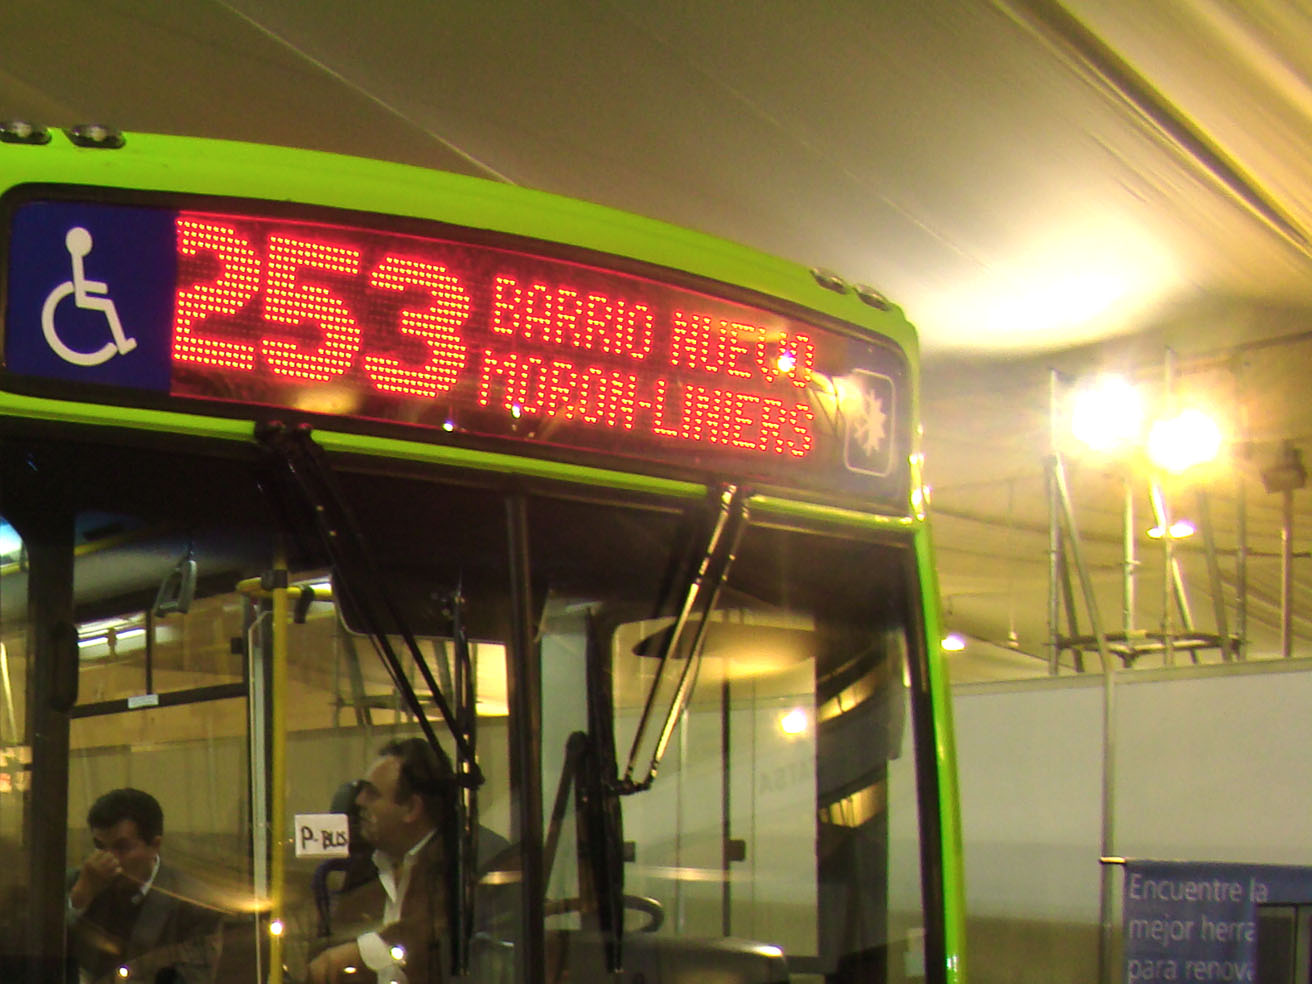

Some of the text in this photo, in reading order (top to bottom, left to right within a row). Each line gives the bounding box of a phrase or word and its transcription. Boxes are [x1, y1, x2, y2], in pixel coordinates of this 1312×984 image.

[173, 218, 472, 399] 253
[494, 275, 815, 388] BARRIO NUEVO
[479, 349, 815, 457] MORON-LINIERS
[1128, 873, 1269, 903] Encuentre la
[1129, 914, 1194, 947] mejor
